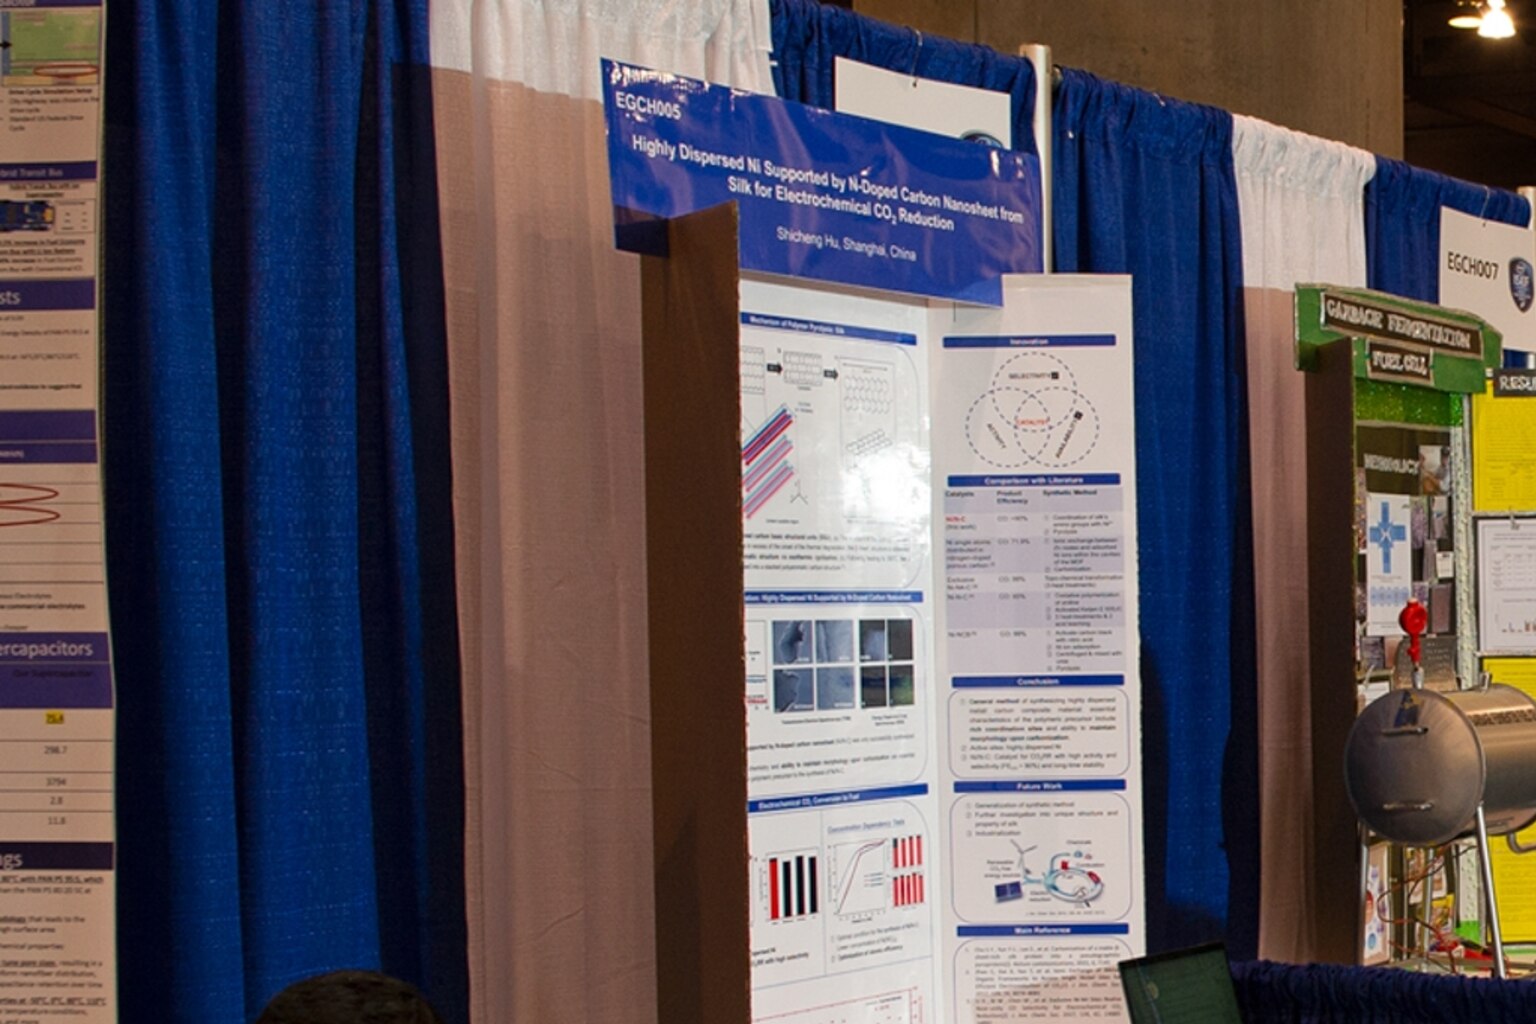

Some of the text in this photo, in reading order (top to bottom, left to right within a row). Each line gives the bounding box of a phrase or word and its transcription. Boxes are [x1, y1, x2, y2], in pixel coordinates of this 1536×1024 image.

[615, 91, 682, 120] EGCH005
[632, 135, 1024, 224] Highly Dispersed Ni Supported by N-Doped Carbon Nanosheet from
[727, 175, 752, 195] Silk
[755, 182, 773, 199] for
[775, 187, 871, 216] Electrochemical
[898, 207, 955, 232] Reduction
[777, 226, 822, 248] Shicheng
[890, 245, 917, 261] China
[1447, 251, 1499, 280] EGCH007
[1372, 351, 1403, 371] FUEL
[1016, 677, 1060, 686] Conclusion
[1017, 781, 1063, 790] Future Work
